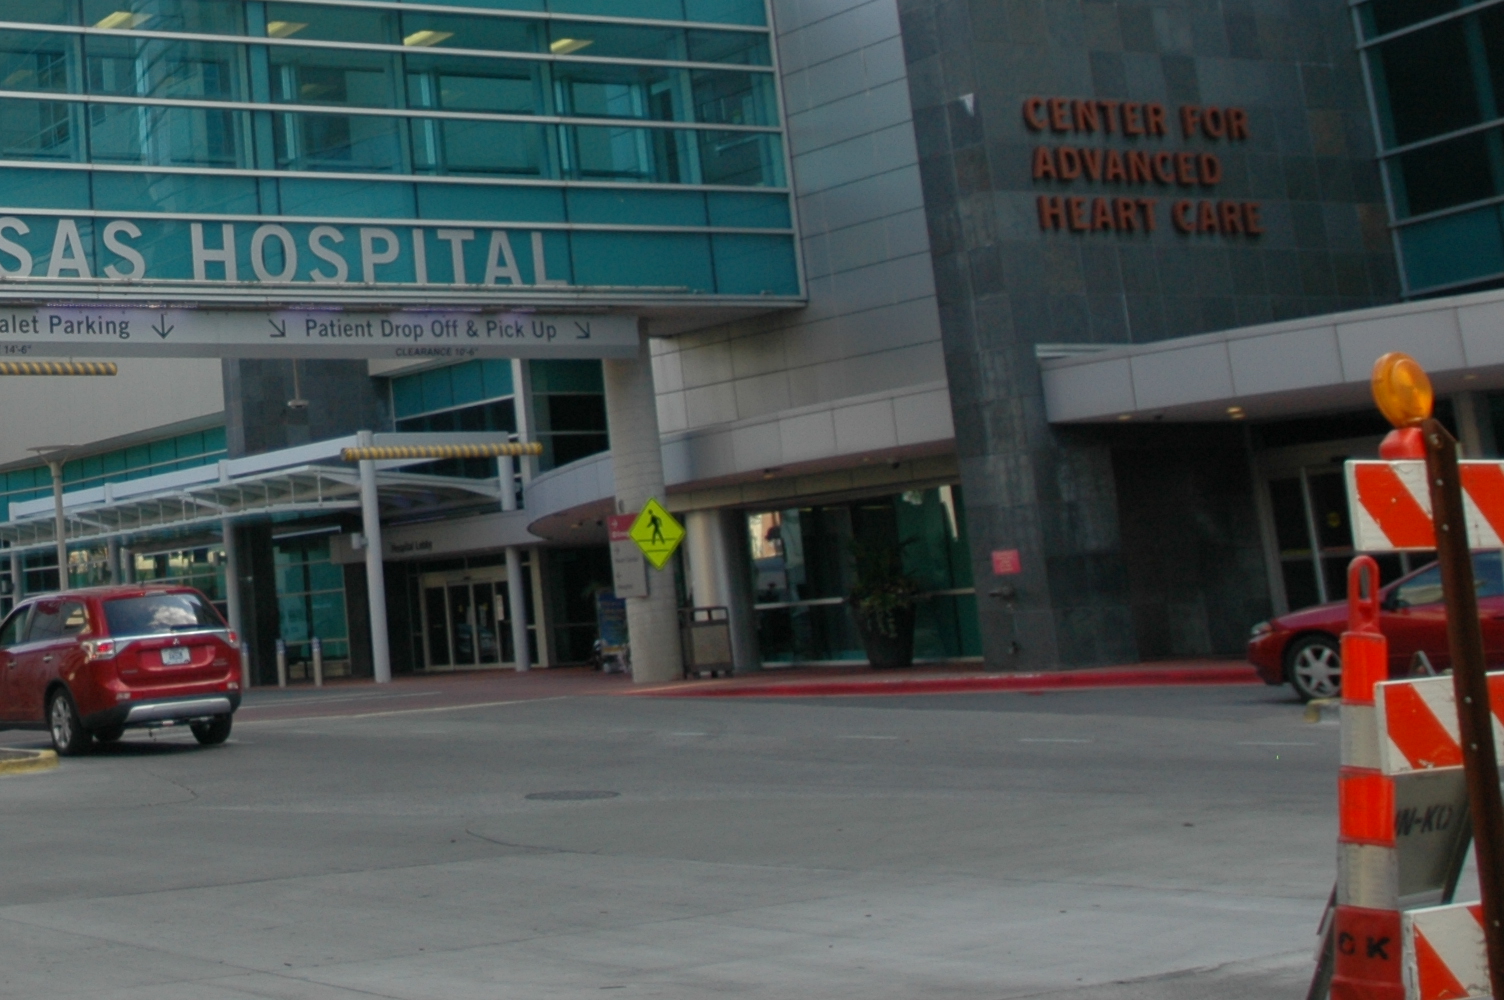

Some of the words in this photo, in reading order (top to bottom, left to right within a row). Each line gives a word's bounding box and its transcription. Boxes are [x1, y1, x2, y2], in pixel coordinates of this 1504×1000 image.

[1023, 96, 1168, 136] CENTER
[1180, 104, 1250, 139] FOR
[1032, 146, 1222, 184] ADVANCED
[1037, 195, 1158, 232] HEART
[1172, 200, 1265, 236] CARE
[190, 223, 568, 285] HOSPITAL
[49, 315, 131, 340] Parking
[305, 318, 373, 338] Patient
[381, 319, 424, 342] Drop
[431, 319, 458, 338] Off
[466, 319, 479, 338] &
[486, 320, 525, 338] Pick
[533, 321, 557, 342] Up
[395, 347, 452, 357] CLEARANCE
